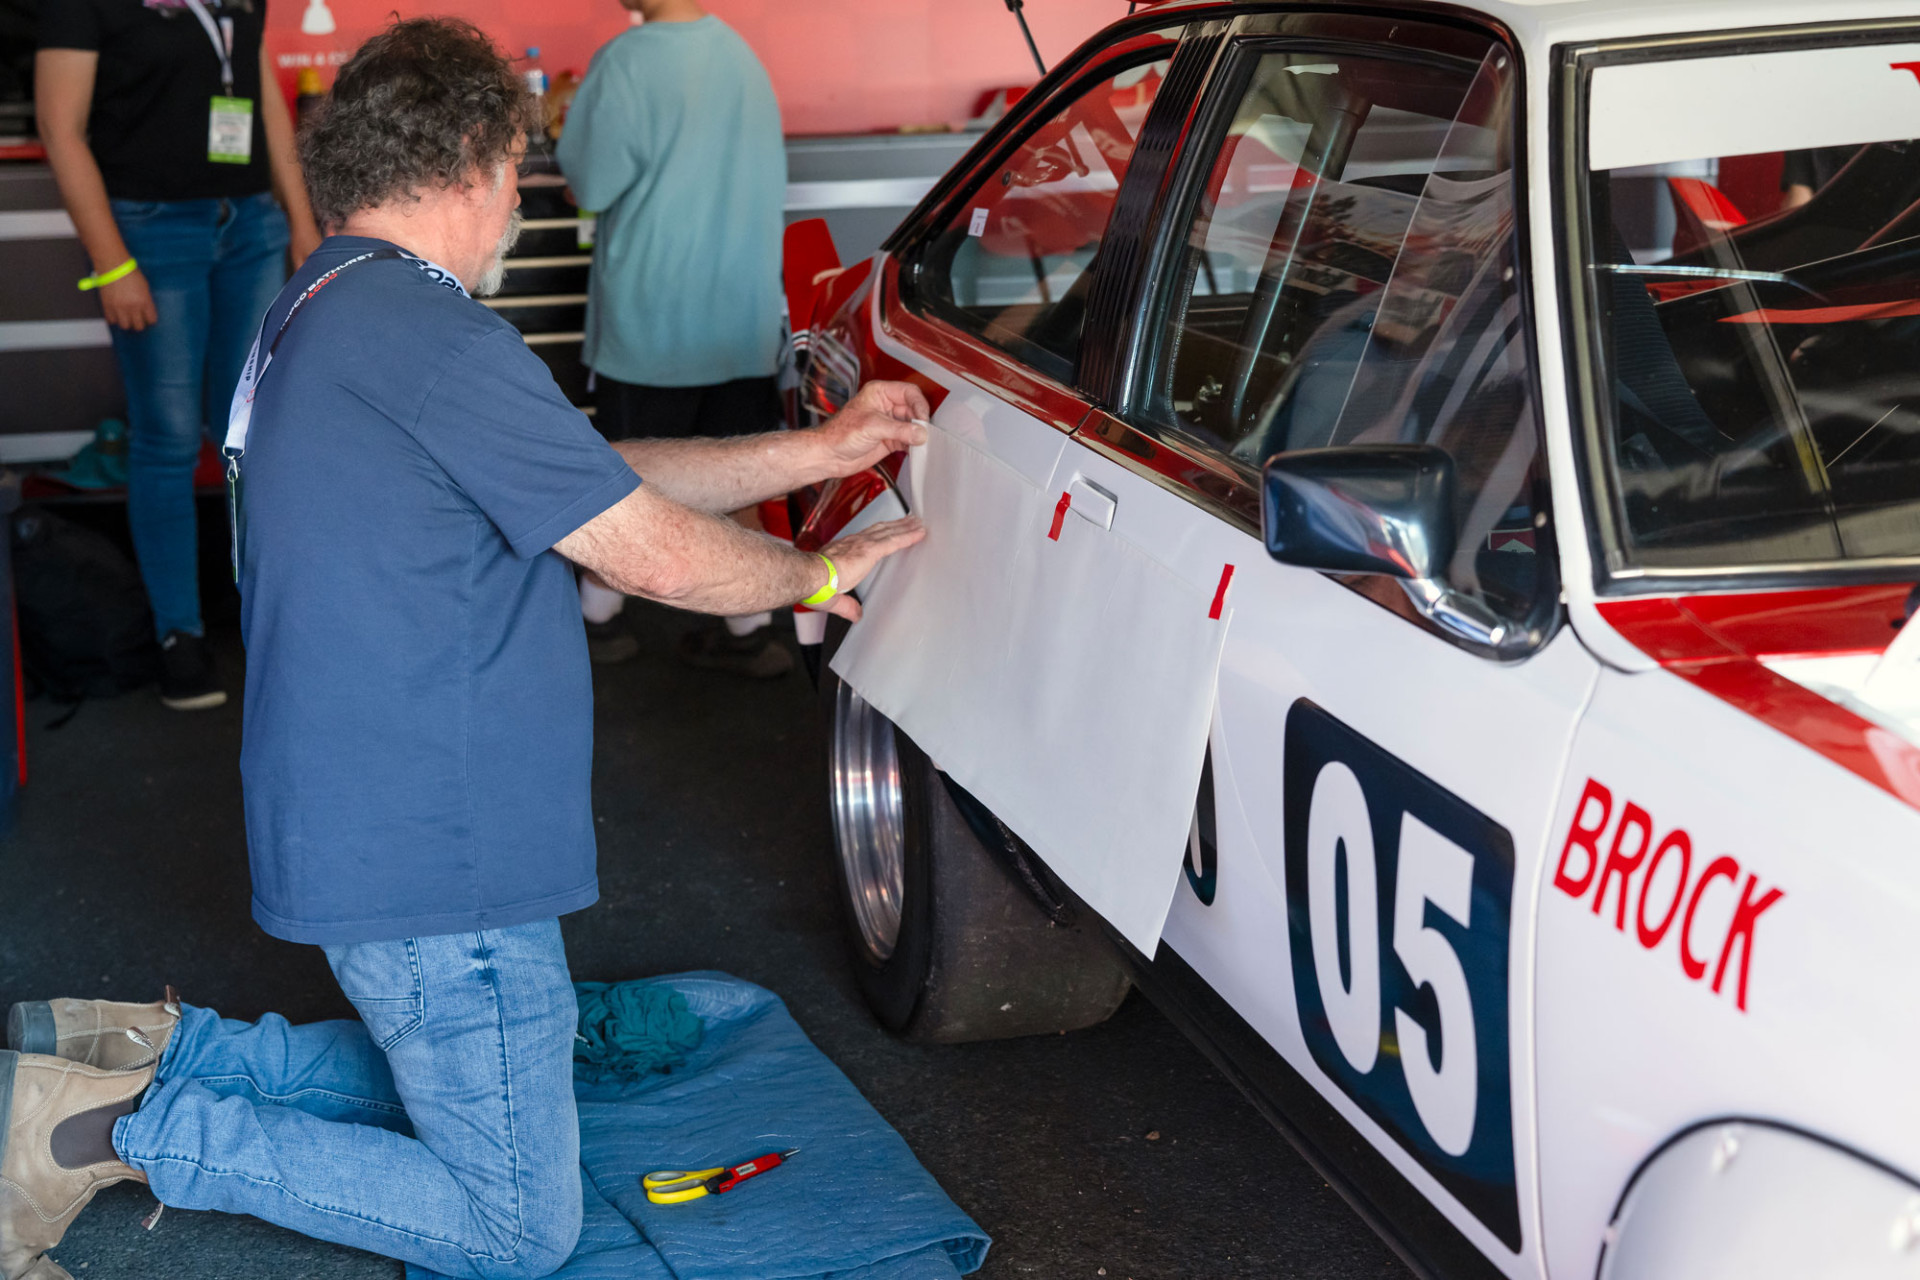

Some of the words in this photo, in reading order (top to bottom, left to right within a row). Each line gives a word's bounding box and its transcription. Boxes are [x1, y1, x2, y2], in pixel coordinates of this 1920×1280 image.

[307, 252, 375, 292] BATHURST
[307, 272, 338, 299] 1000
[1307, 760, 1479, 1157] 05
[1553, 776, 1785, 1014] BROCK
